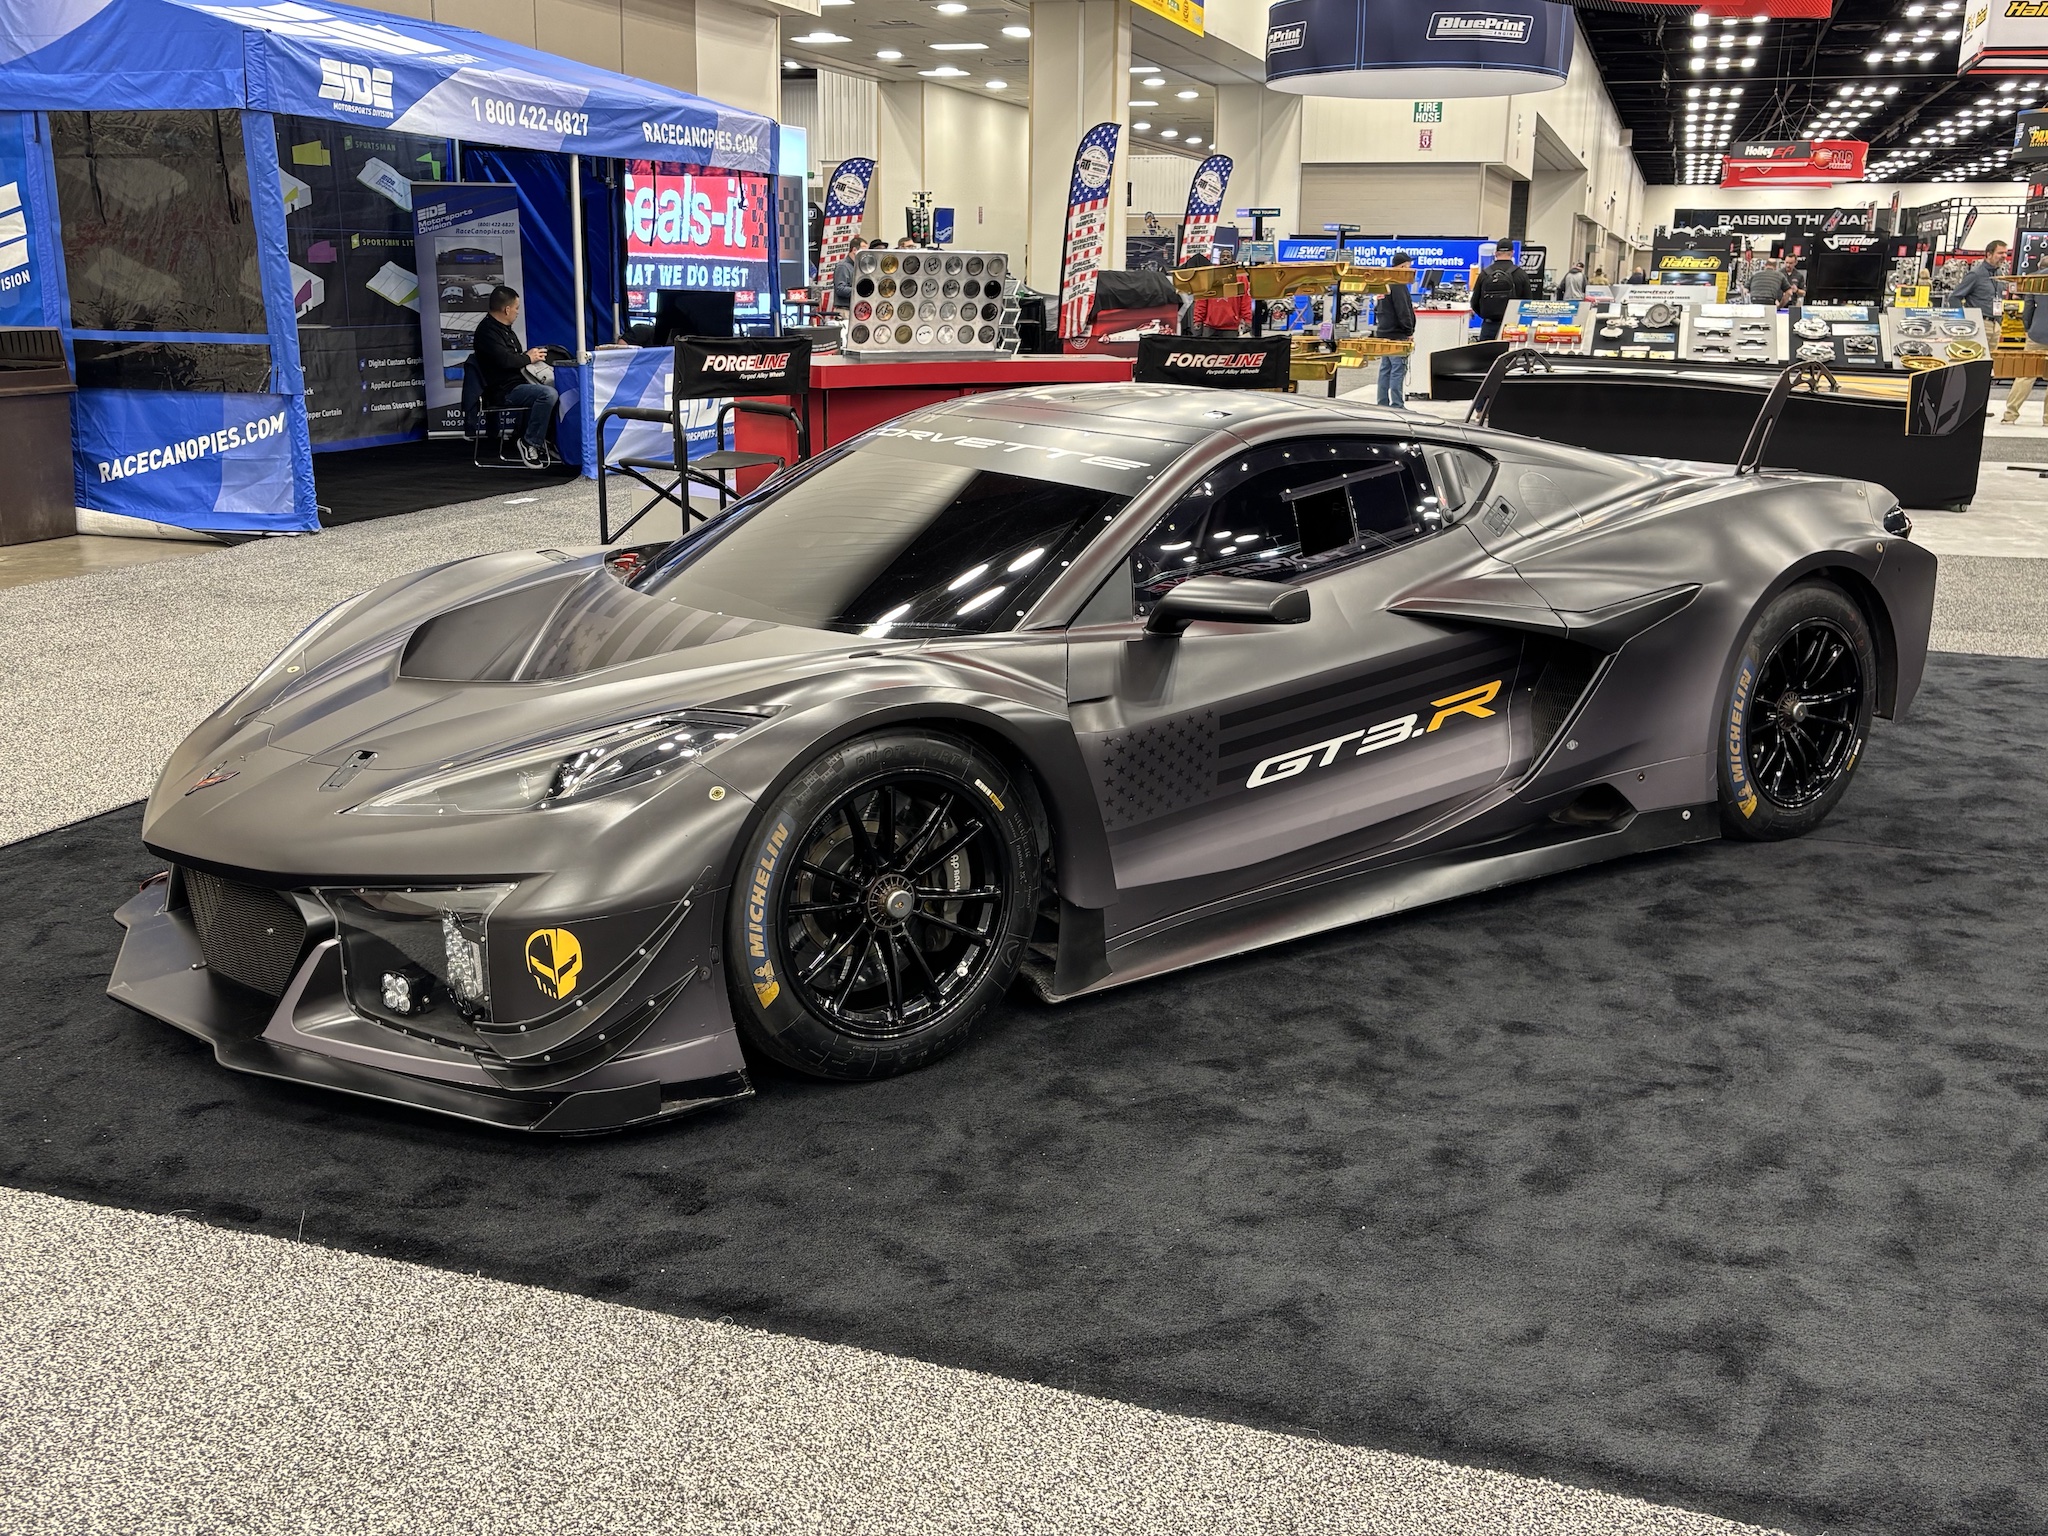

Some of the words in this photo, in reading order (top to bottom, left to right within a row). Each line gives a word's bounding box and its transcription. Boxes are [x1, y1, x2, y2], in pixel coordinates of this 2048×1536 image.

[1437, 17, 1526, 31] BluePrint
[333, 102, 372, 116] MOTORSPORTS
[372, 110, 394, 119] DIVISION
[1418, 102, 1438, 112] FIRE
[471, 96, 482, 122] 1
[485, 98, 516, 127] 800
[518, 104, 588, 136] 422-6827
[1416, 112, 1440, 122] HOSE
[642, 121, 758, 154] RACECANOPIES.COM
[1744, 146, 1774, 158] Holley
[418, 208, 474, 228] Motorsports
[1718, 214, 1792, 226] RAISING
[418, 221, 452, 234] Division
[362, 238, 400, 246] SPORTSMAN
[1354, 246, 1377, 257] High
[1354, 257, 1387, 268] Racing
[1418, 256, 1464, 266] Elements
[1660, 257, 1720, 268] Haltech
[658, 264, 684, 286] WE
[686, 264, 708, 287] DO
[712, 265, 749, 288] BEST
[368, 358, 386, 368] Digital
[387, 358, 406, 366] Custom
[702, 352, 791, 372] FORGELINE
[1164, 352, 1267, 368] FORGELINE
[370, 381, 391, 391] Applied
[322, 408, 342, 418] Curtain
[371, 403, 391, 412] Custom
[392, 401, 416, 410] Storage
[98, 412, 285, 484] RACECANOPIES.COM
[1730, 668, 1752, 783] MICHELIN
[1246, 680, 1502, 790] GT3.R
[855, 745, 905, 770] PILOT
[748, 822, 790, 958] MICHELIN
